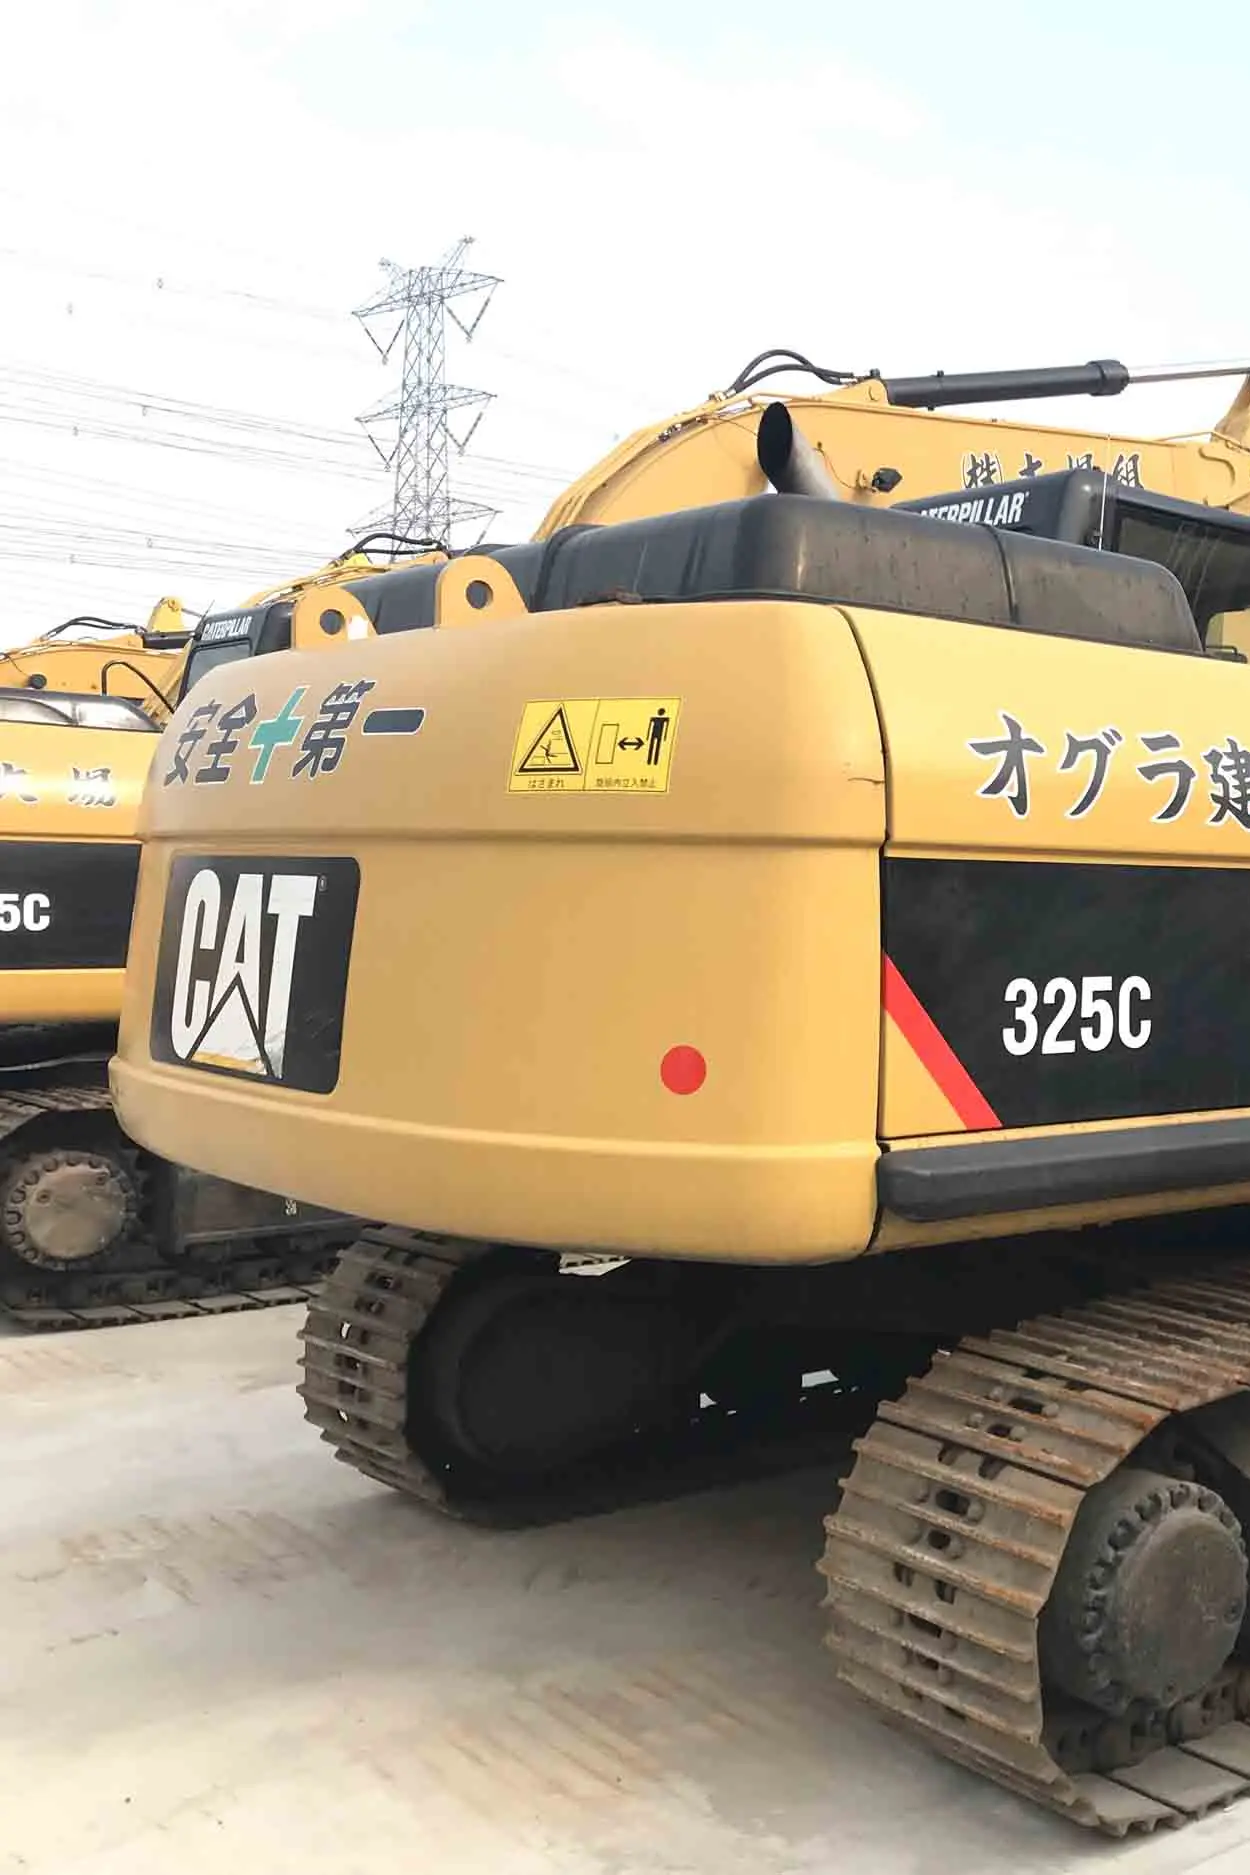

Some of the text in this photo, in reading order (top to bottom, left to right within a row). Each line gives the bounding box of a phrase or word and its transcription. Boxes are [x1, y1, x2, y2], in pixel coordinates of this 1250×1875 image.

[202, 616, 252, 641] CATERPILLAR
[171, 868, 318, 1079] CAT
[1002, 975, 1152, 1056] 325C
